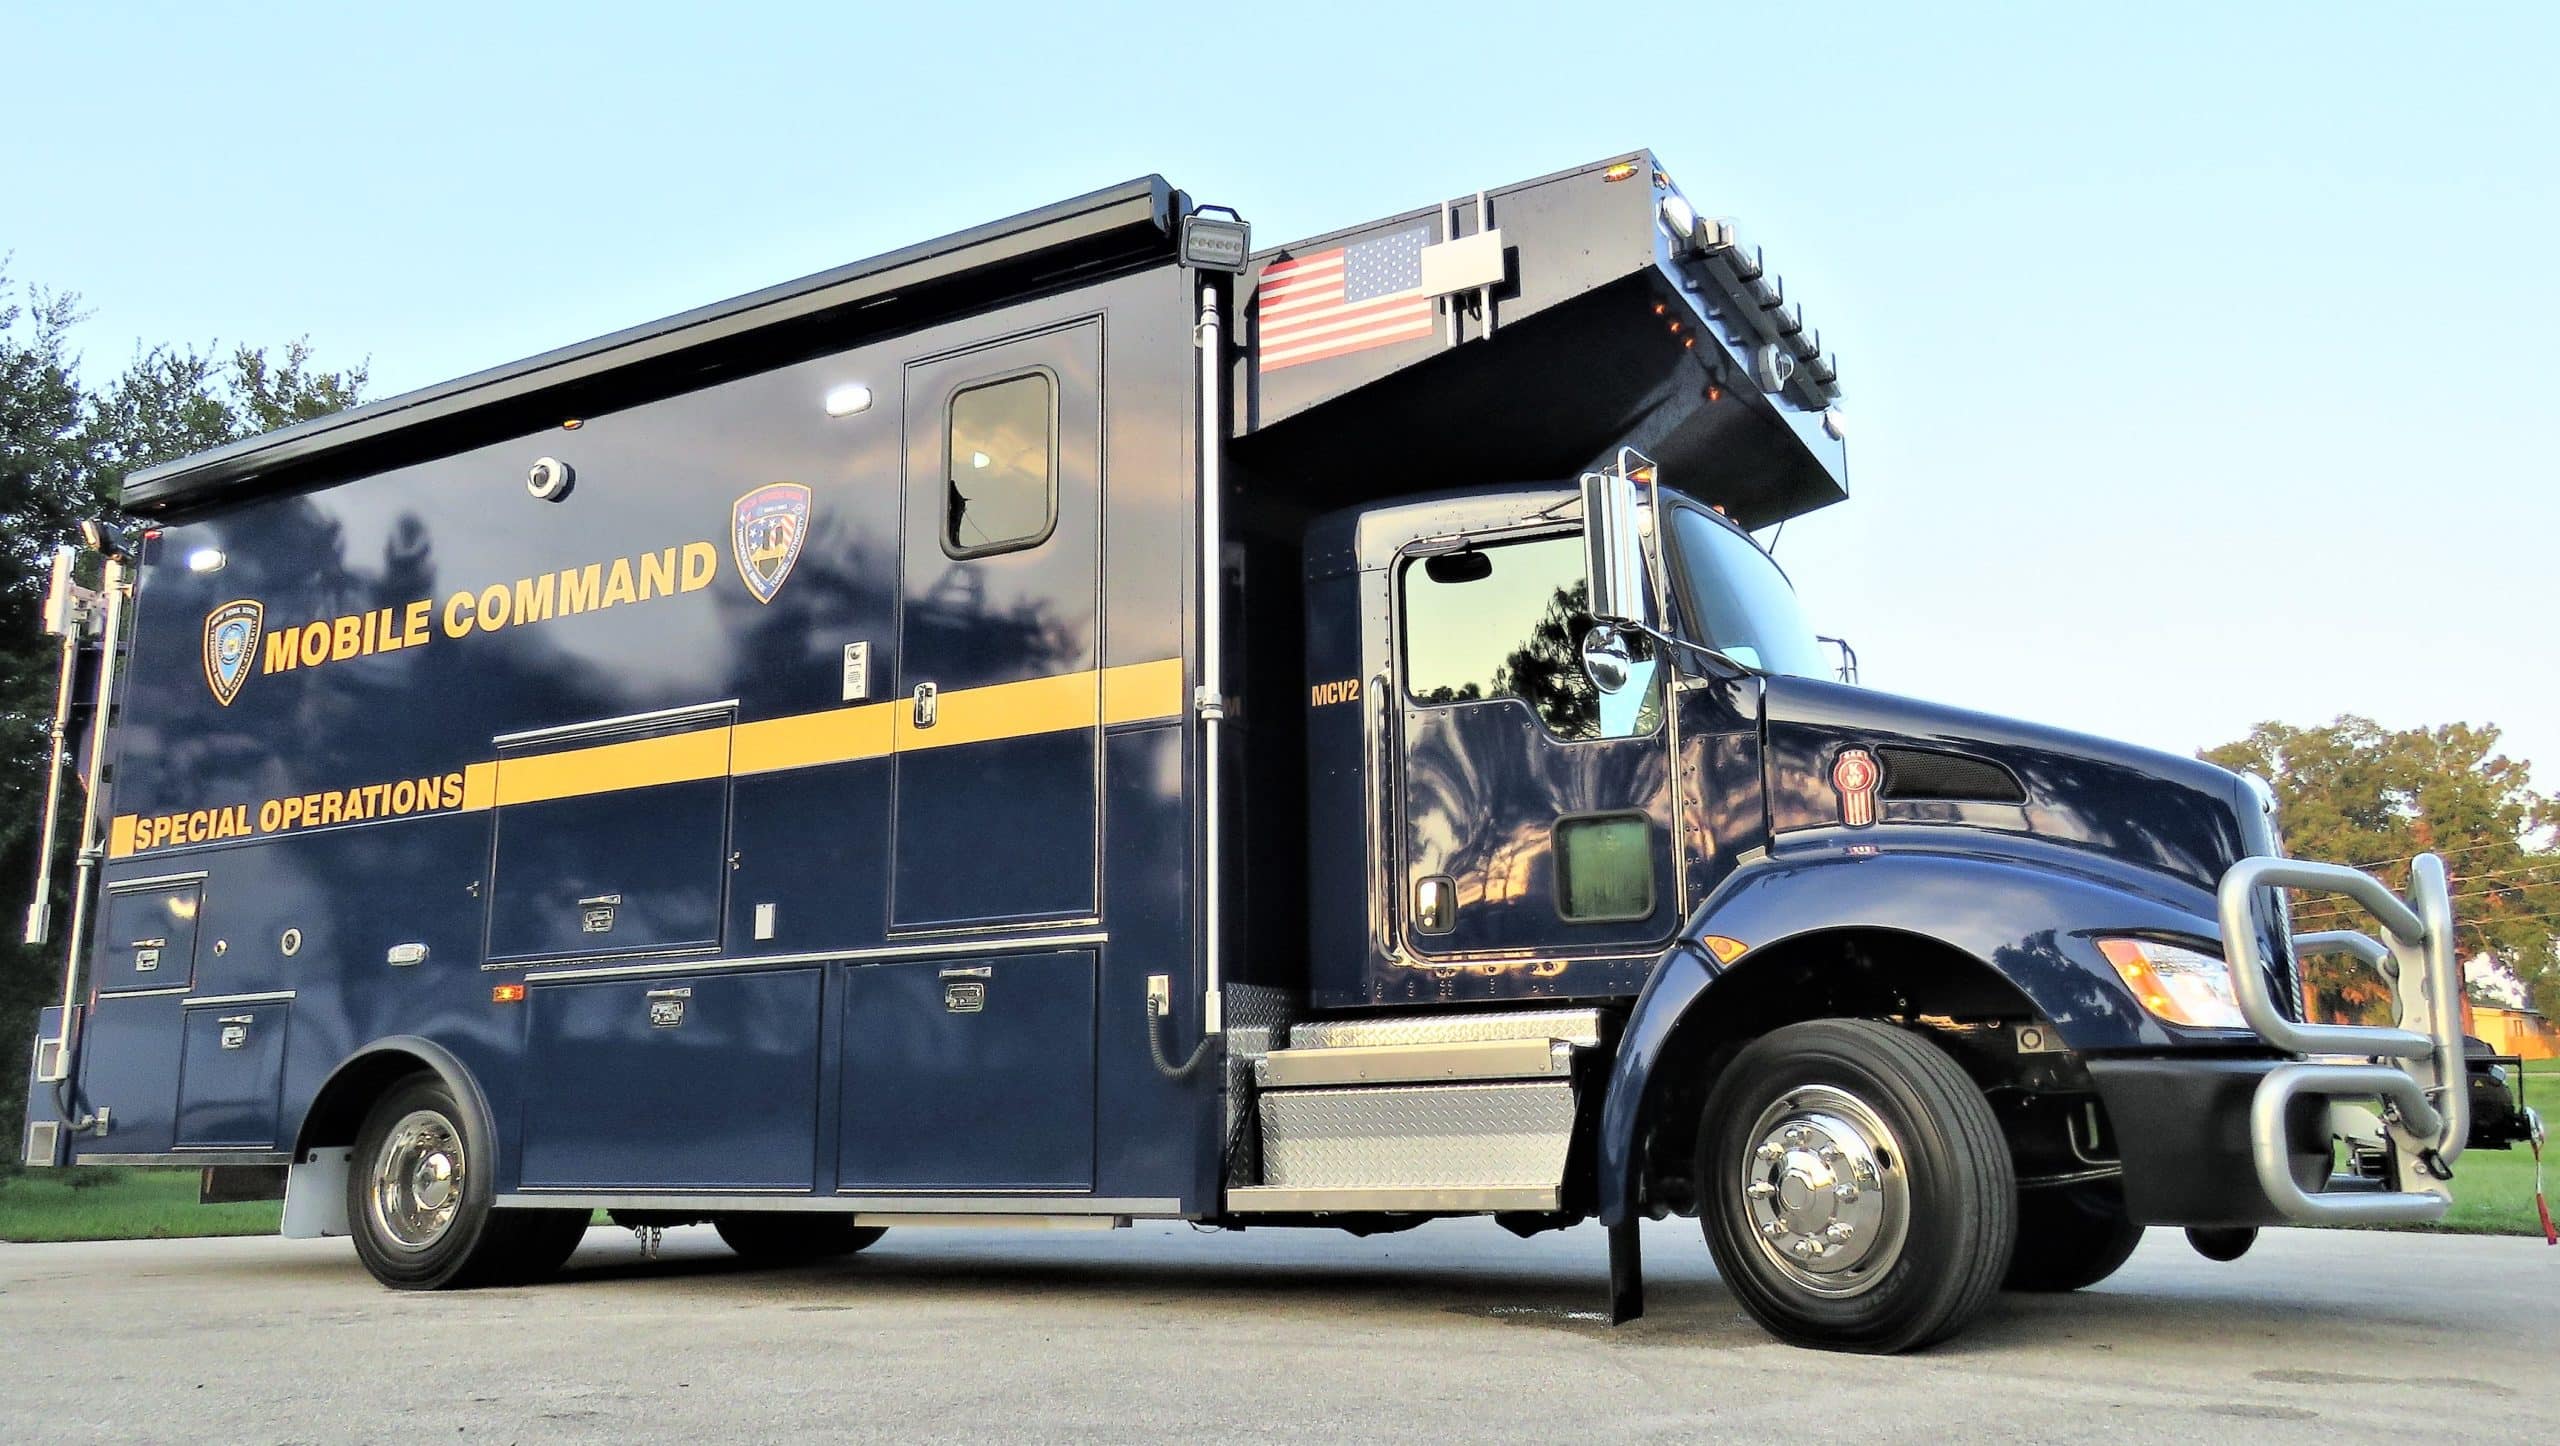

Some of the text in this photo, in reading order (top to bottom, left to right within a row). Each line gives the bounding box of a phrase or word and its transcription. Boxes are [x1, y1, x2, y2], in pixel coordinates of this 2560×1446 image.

[262, 599, 432, 675] MOBILE
[443, 540, 718, 639] COMMAND
[1311, 678, 1360, 707] MCV2
[134, 772, 465, 852] SPECIAL OPERATIONS
